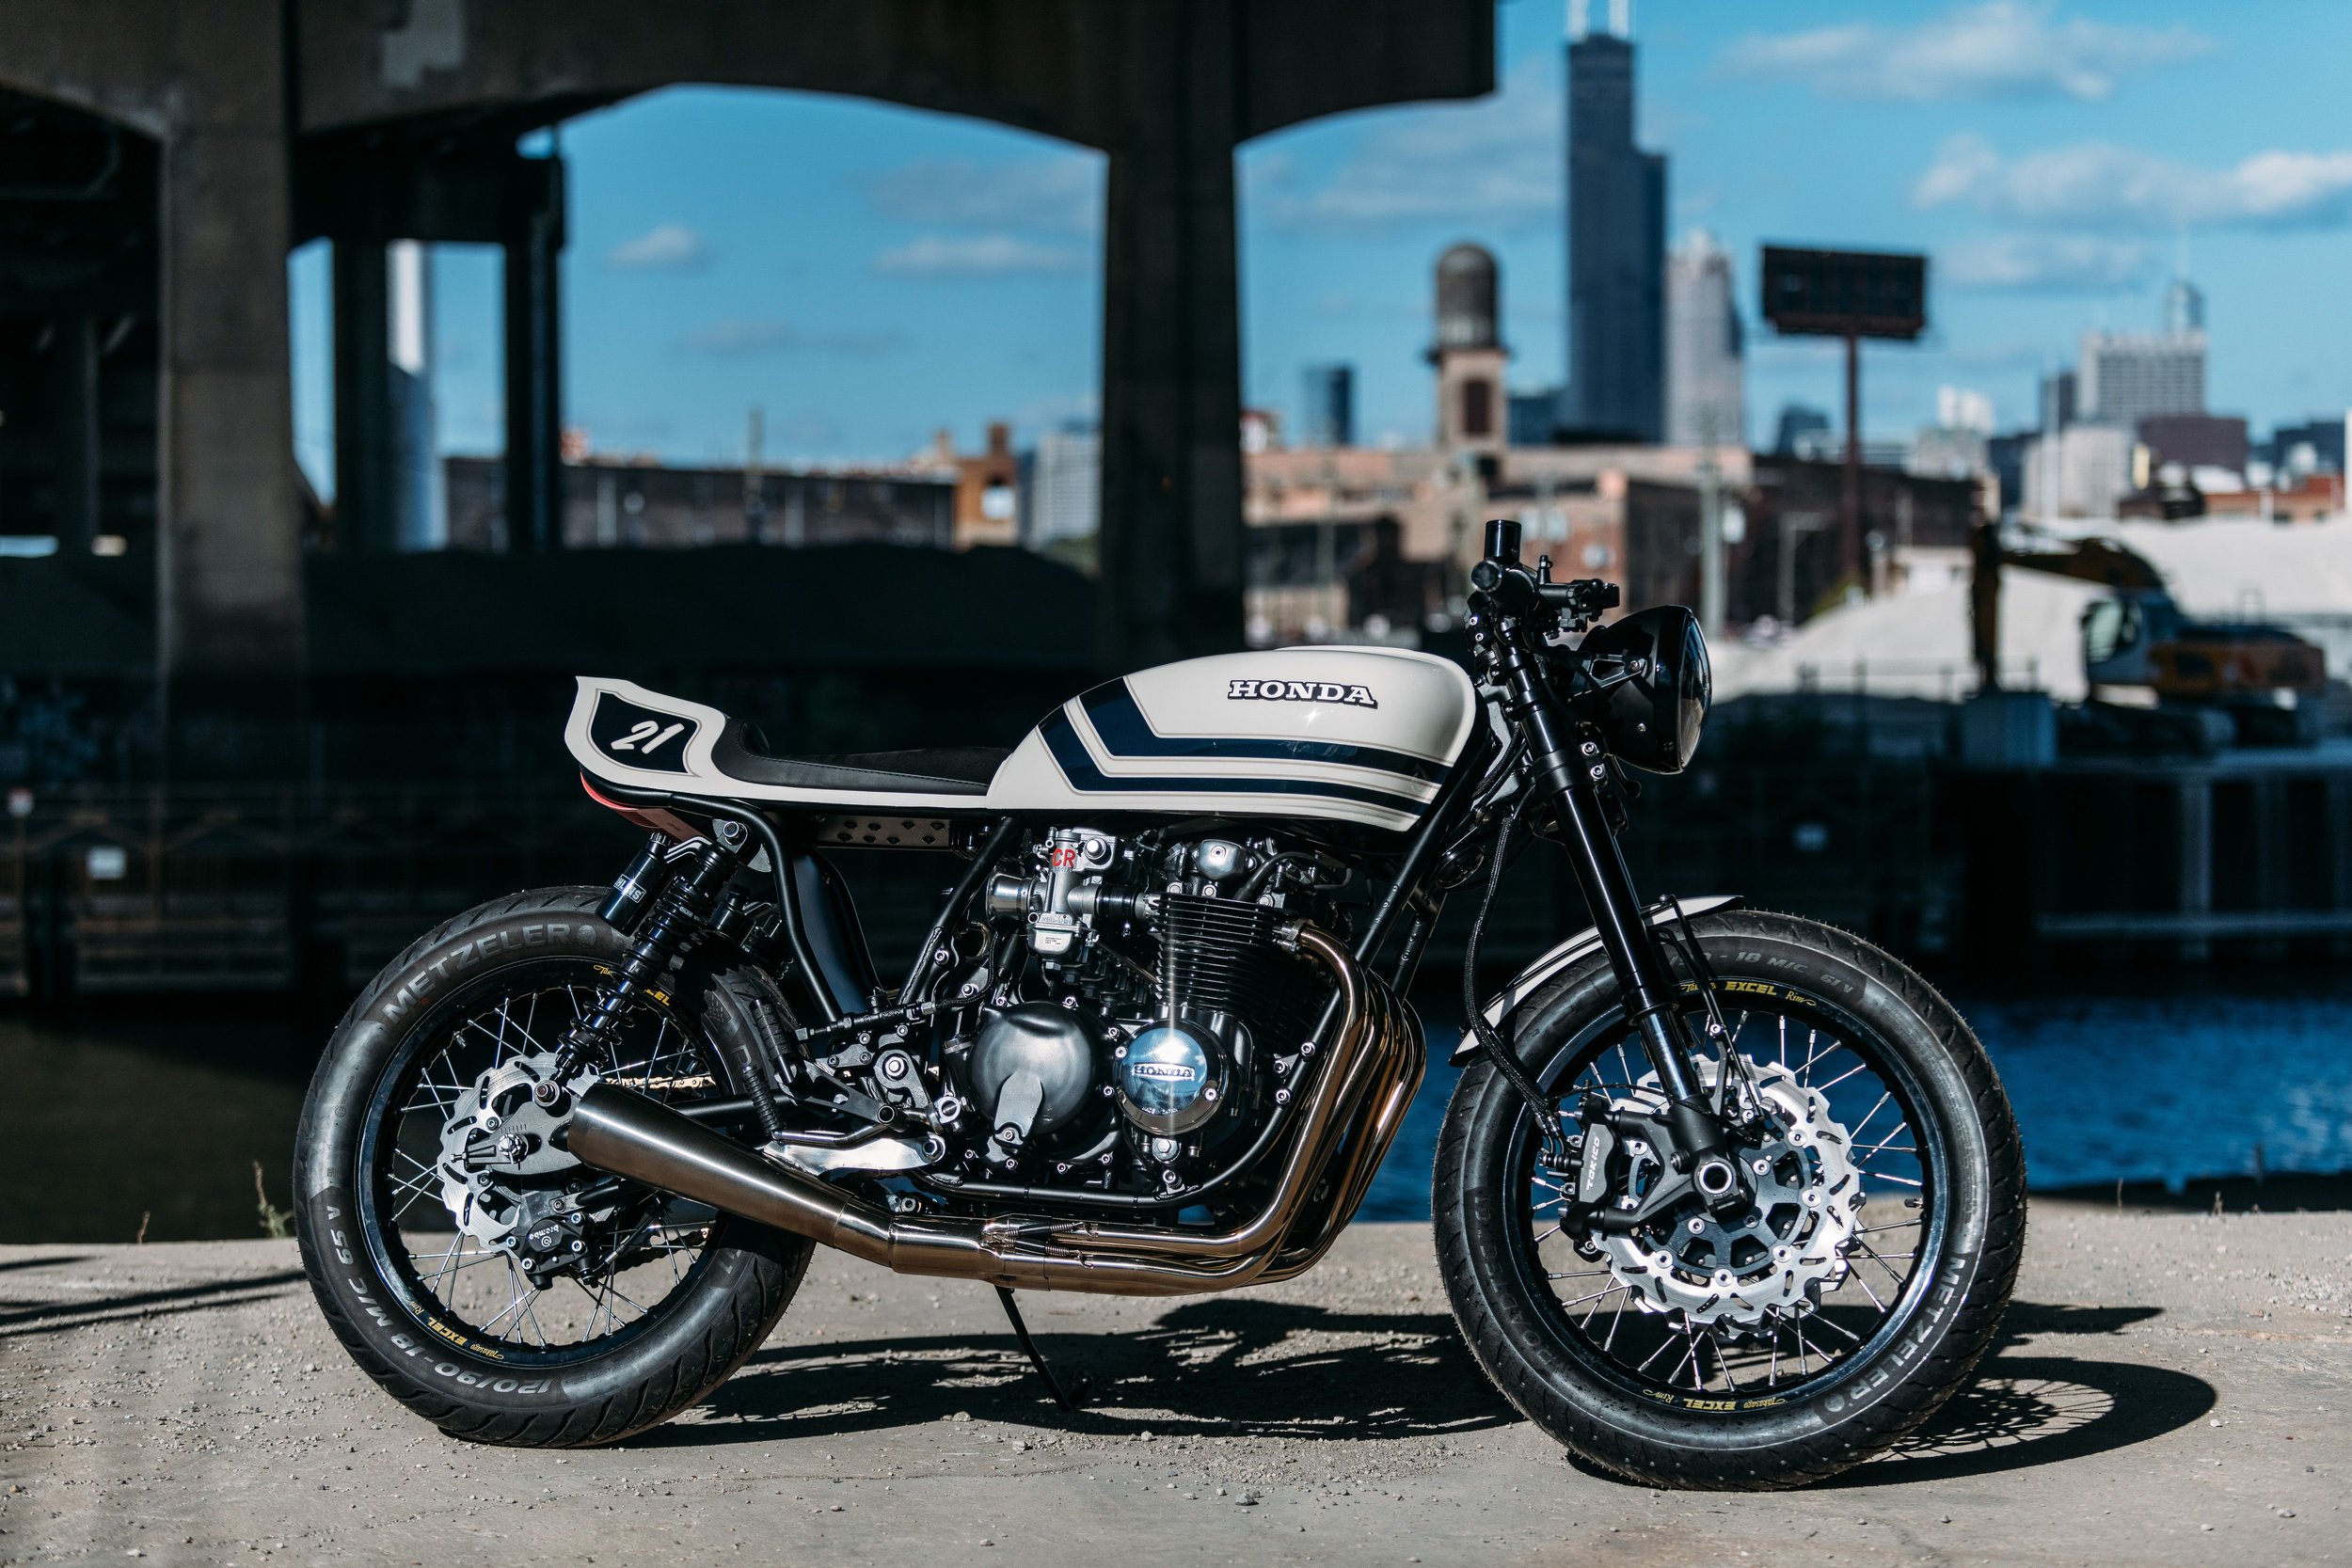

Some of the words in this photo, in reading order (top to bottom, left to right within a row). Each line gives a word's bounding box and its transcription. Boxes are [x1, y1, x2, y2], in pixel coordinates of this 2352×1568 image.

[1228, 680, 1377, 707] HONDA
[610, 721, 685, 754] 21
[1052, 847, 1076, 868] CR
[1735, 952, 1762, 963] 18
[382, 923, 571, 1024] METZELER
[1724, 981, 1777, 996] EXCEL
[1786, 990, 1817, 1006] Rim
[1586, 1136, 1600, 1191] TOKICO
[326, 1205, 342, 1221] V
[529, 1224, 560, 1240] brembo
[330, 1228, 354, 1265] 65
[348, 1276, 393, 1327] M/C
[427, 1316, 469, 1346] EXCEL
[1850, 1256, 1966, 1401] METZELER
[1682, 1398, 1738, 1411] EXCEL
